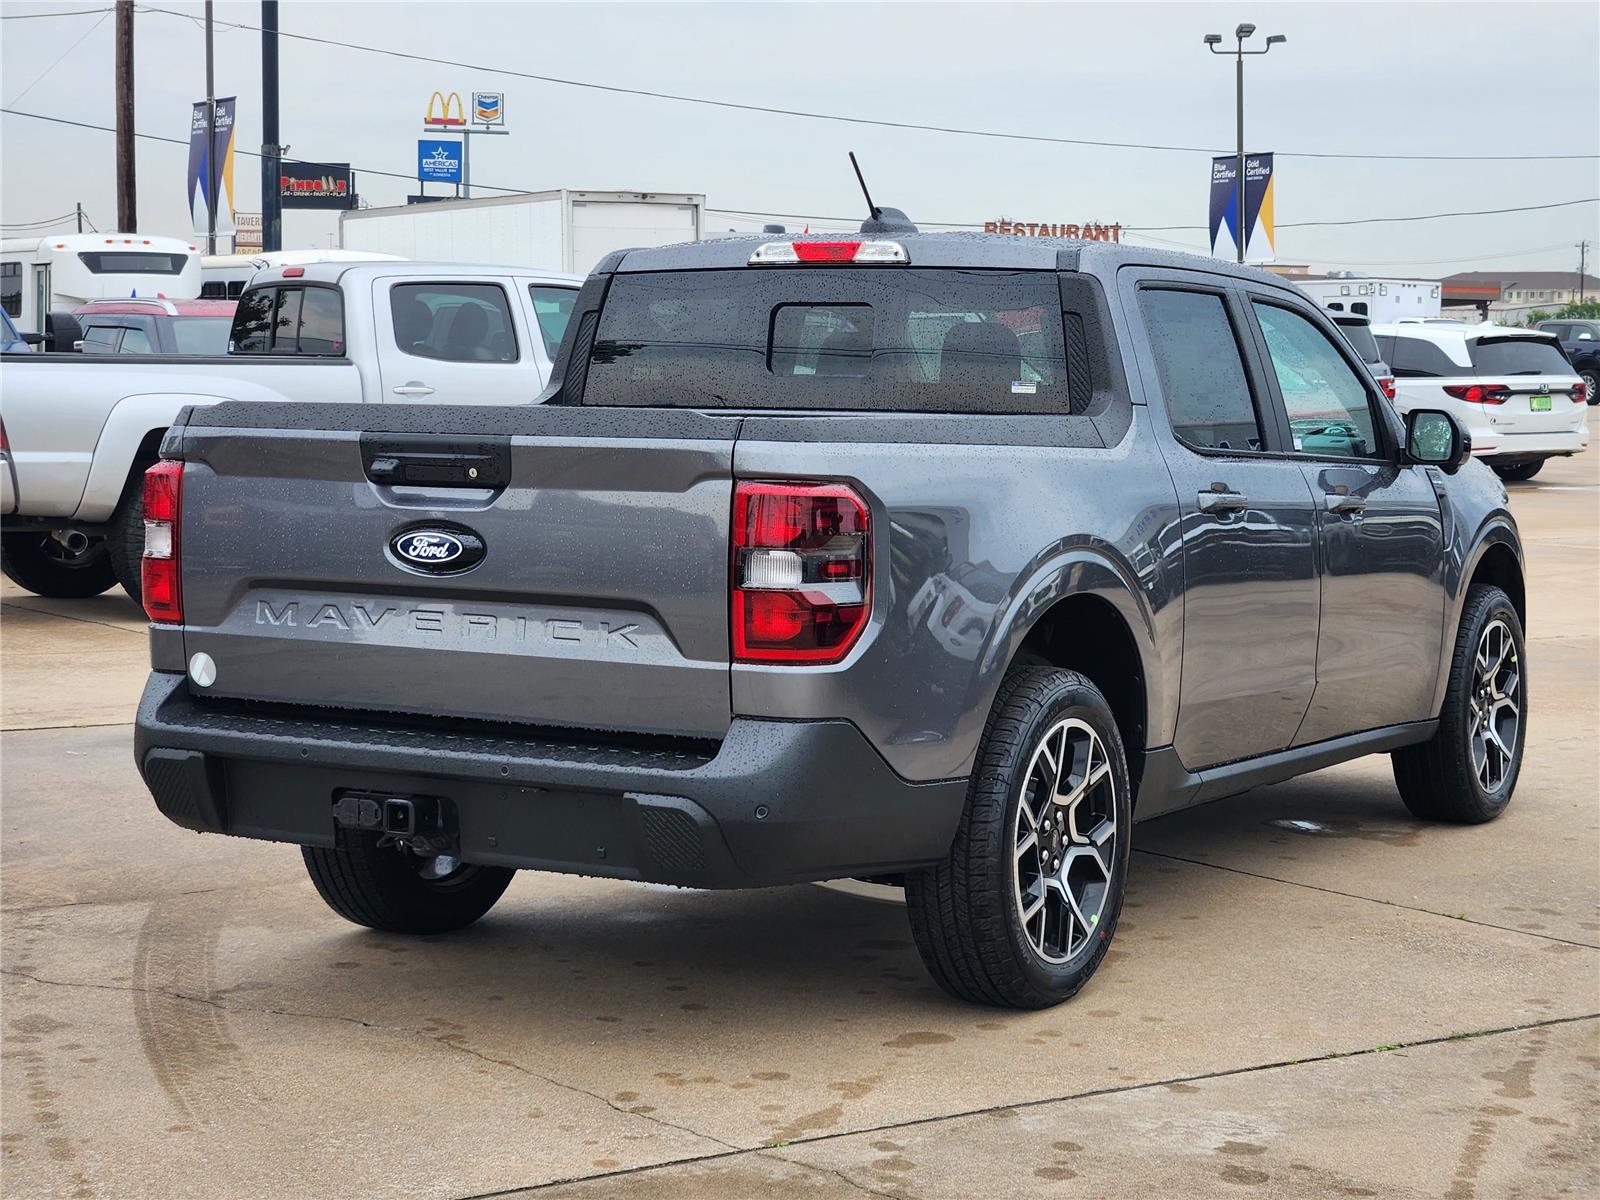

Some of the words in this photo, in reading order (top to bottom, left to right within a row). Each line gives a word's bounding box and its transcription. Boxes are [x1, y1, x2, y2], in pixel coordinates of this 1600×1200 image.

[193, 110, 203, 119] Blue
[216, 106, 226, 116] Gold
[215, 115, 233, 126] Certified
[1213, 163, 1227, 171] Blue
[1246, 160, 1260, 168] Gold
[1213, 170, 1236, 179] Certified
[1246, 166, 1270, 176] Certified
[237, 216, 262, 226] TAVER
[984, 222, 1122, 242] RESTAURANT
[408, 536, 450, 558] Ford
[255, 599, 640, 649] MAVERICK
